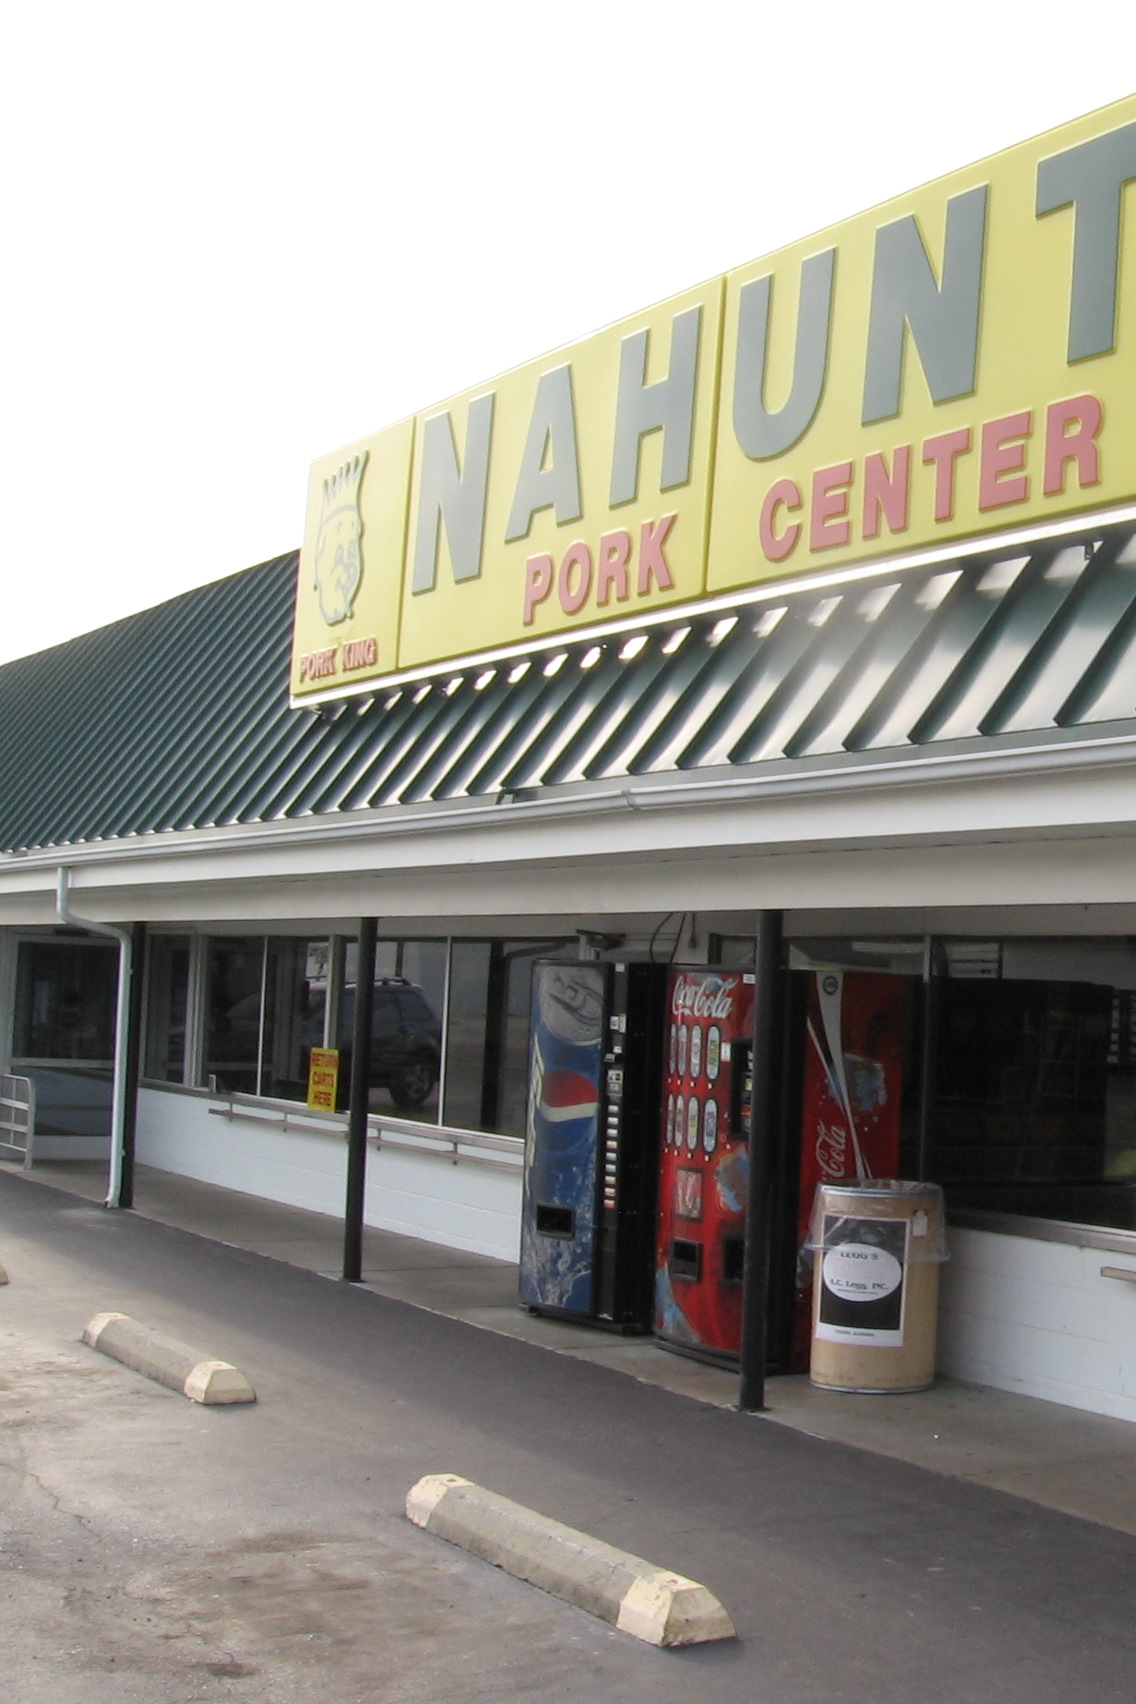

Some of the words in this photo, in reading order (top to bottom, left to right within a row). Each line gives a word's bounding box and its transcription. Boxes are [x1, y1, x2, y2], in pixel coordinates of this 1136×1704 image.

[522, 510, 679, 628] PORK
[758, 393, 1103, 562] CENTER
[299, 644, 338, 683] PORK
[342, 634, 378, 672] KING
